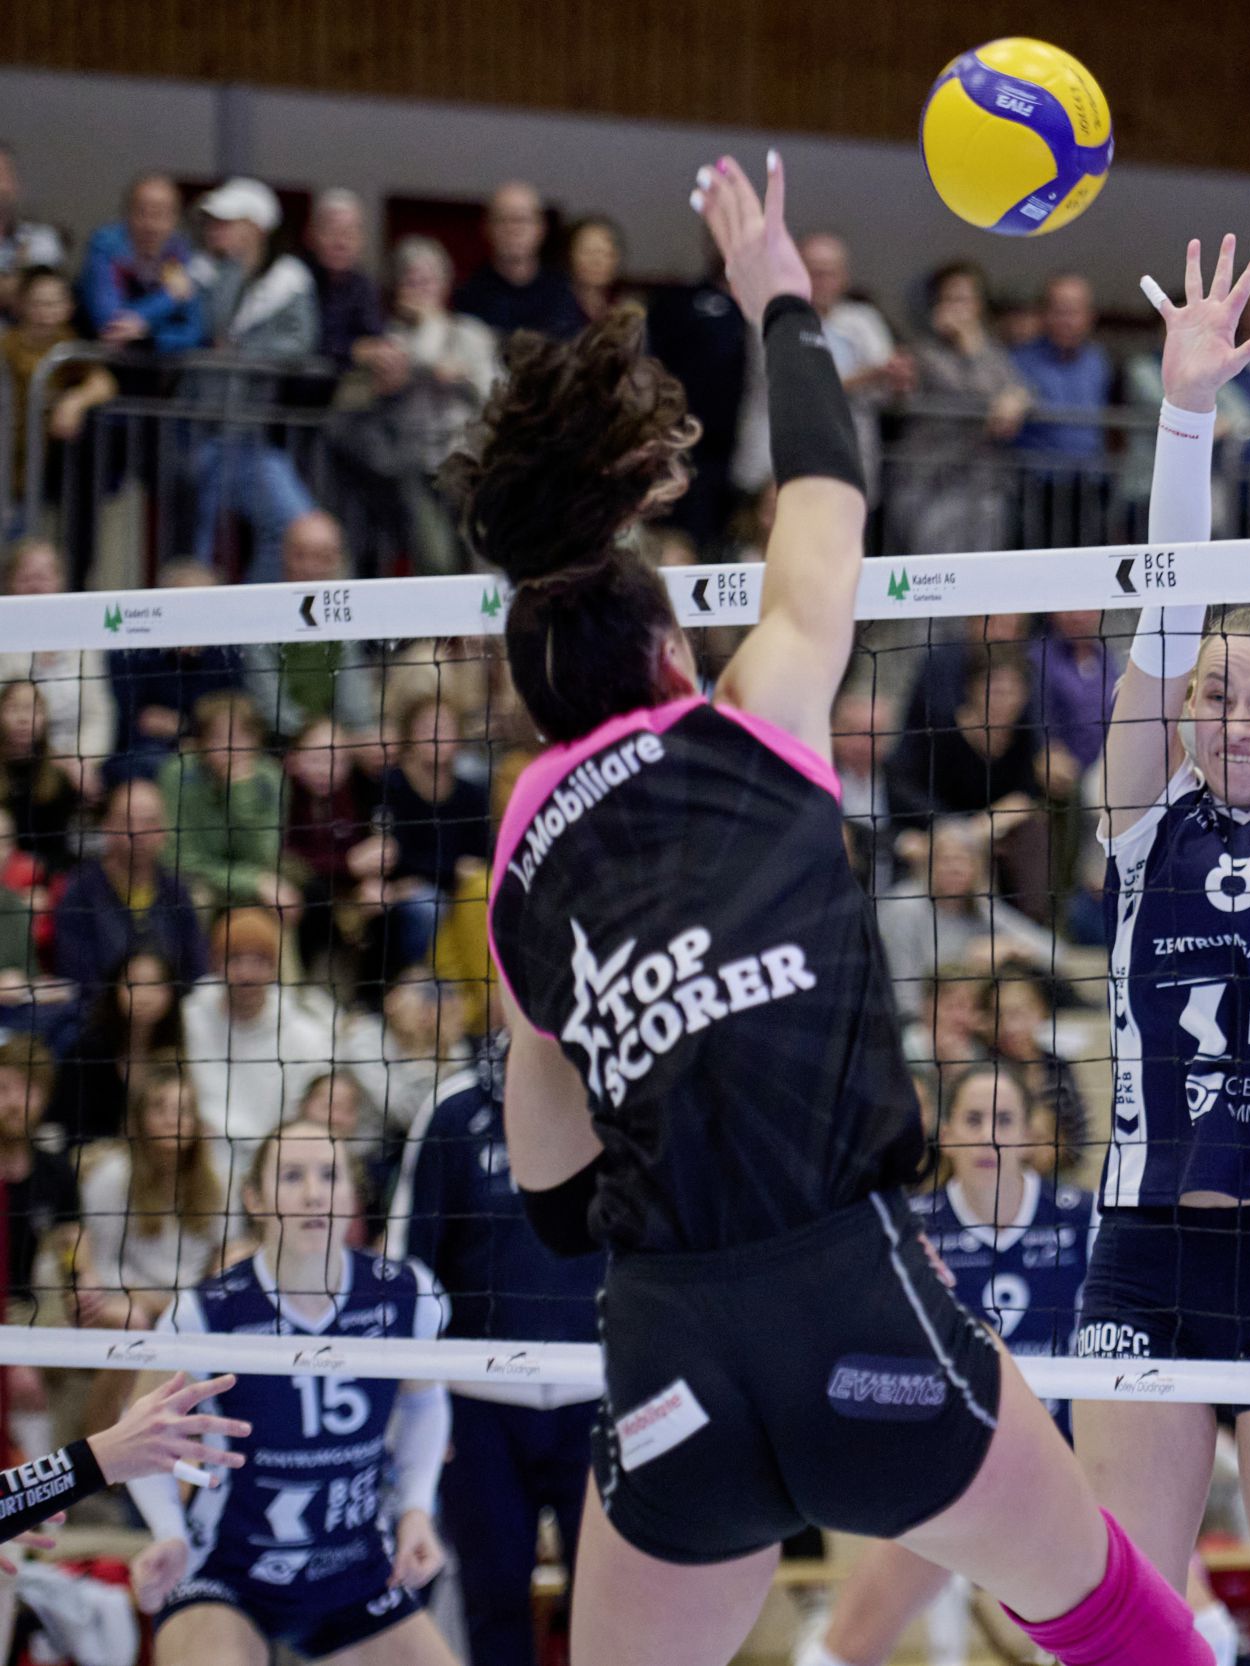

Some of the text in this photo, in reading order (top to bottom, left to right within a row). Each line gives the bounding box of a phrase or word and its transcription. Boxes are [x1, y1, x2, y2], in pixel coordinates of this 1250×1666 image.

[1144, 552, 1176, 569] BCF
[717, 573, 747, 589] BCF
[944, 573, 956, 584] AG
[1145, 571, 1177, 588] FKB
[323, 590, 351, 605] BCF
[719, 591, 749, 607] FKB
[324, 607, 352, 622] FKB
[526, 732, 665, 865] Mobiliare
[598, 926, 711, 1035] TOP
[604, 943, 817, 1108] SCORER
[1123, 1071, 1136, 1105] FKB
[982, 1272, 1031, 1338] 9
[291, 1374, 372, 1438] 15
[26, 1471, 77, 1507] DESIGN
